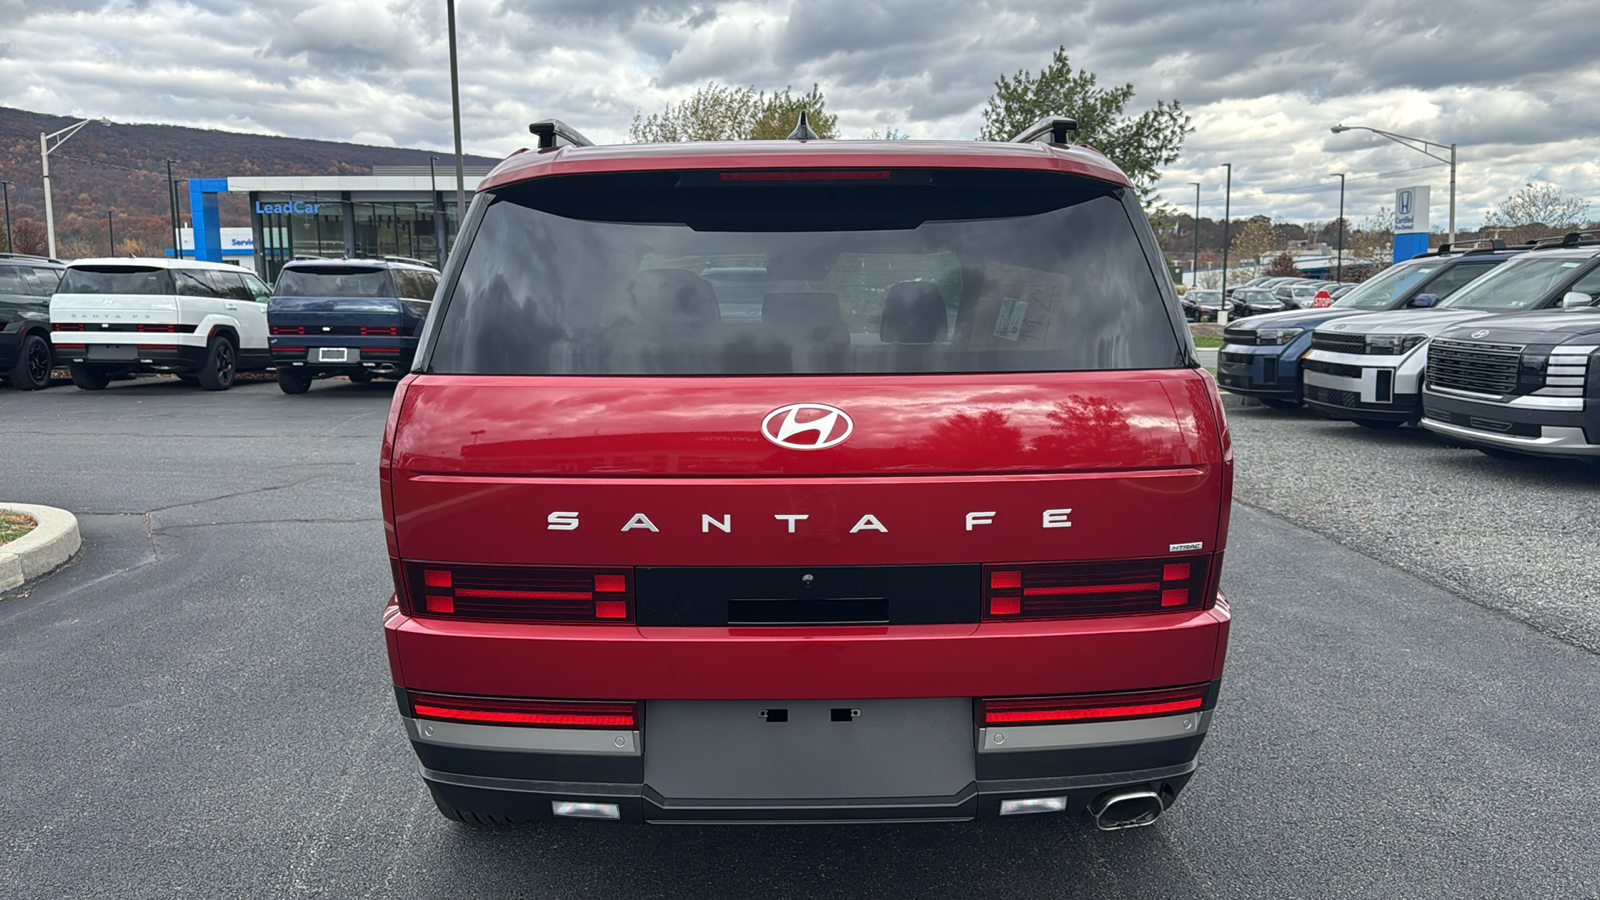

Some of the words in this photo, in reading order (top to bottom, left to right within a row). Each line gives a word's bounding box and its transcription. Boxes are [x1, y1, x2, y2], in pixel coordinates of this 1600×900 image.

[255, 200, 320, 214] LeadCar
[1314, 297, 1331, 307] STOP
[547, 511, 888, 533] SANTA
[965, 508, 1073, 531] FE
[1171, 543, 1202, 551] HTRAC
